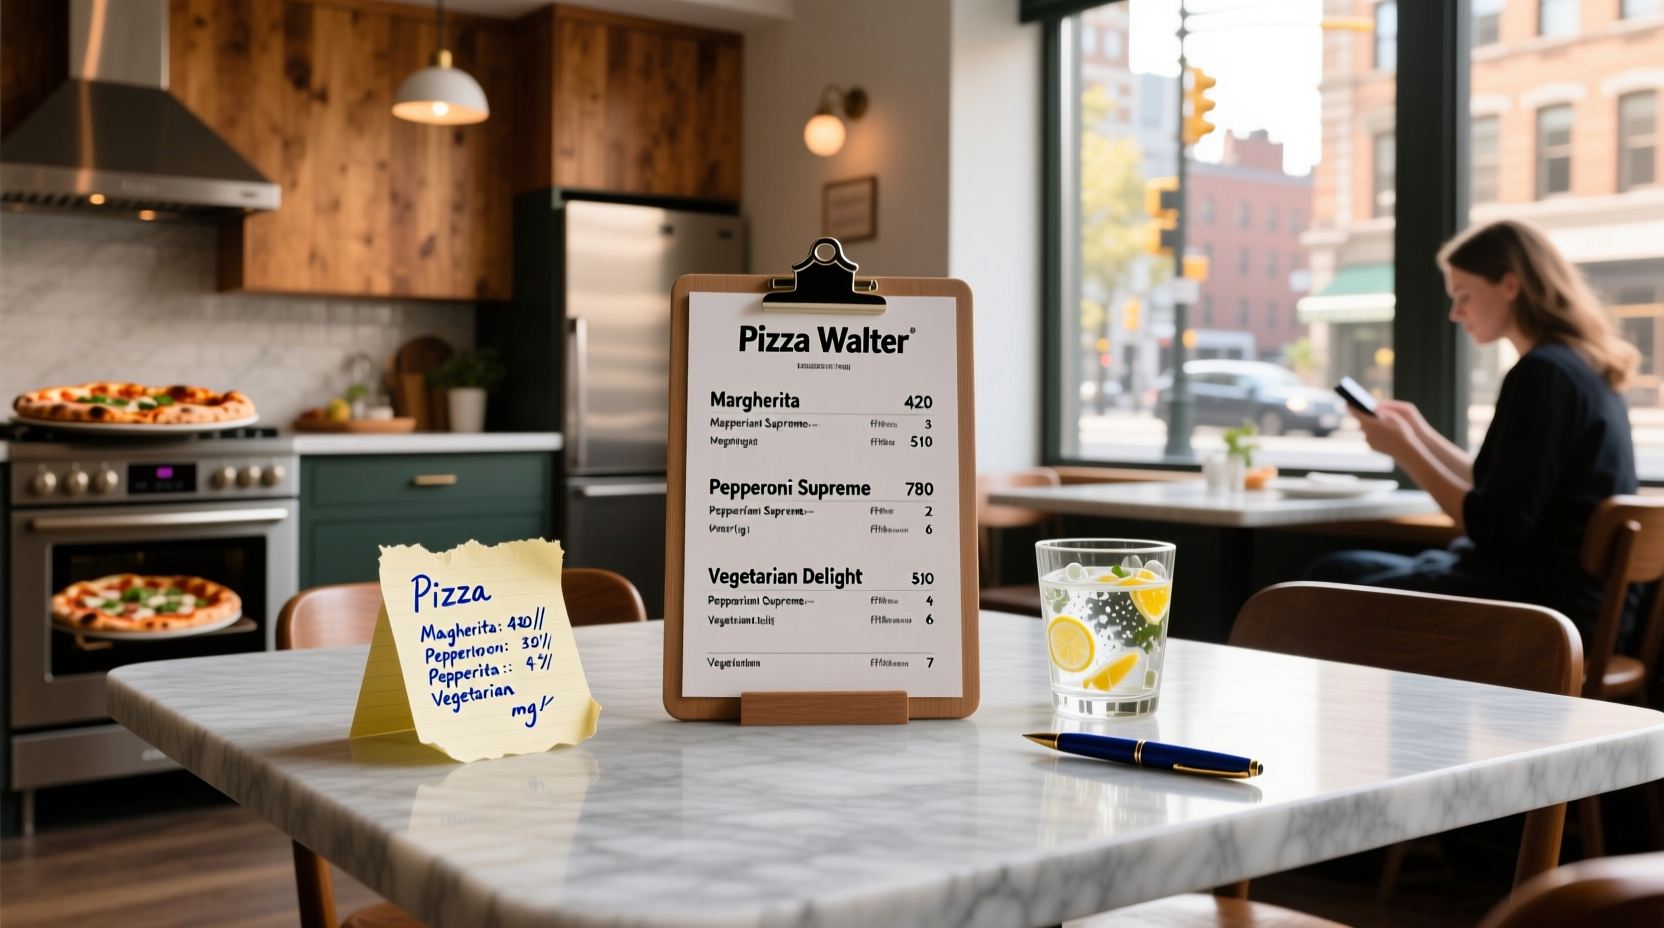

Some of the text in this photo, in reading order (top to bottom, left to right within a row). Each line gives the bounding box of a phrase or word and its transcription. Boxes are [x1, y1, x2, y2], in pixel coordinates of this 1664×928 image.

[739, 325, 810, 352] Pizza
[710, 391, 933, 412] Margherita 420
[925, 419, 932, 429] 3
[910, 436, 933, 447] 510
[709, 478, 934, 500] Pepperoni Supreme 780
[924, 506, 933, 516] 2
[925, 524, 933, 534] 6
[708, 567, 798, 589] Vegetarian
[802, 567, 863, 589] Delight
[411, 574, 492, 613] Pizza
[925, 595, 933, 606] 4
[925, 614, 934, 625] 6
[926, 657, 934, 668] 7
[431, 683, 515, 713] Vegetarian
